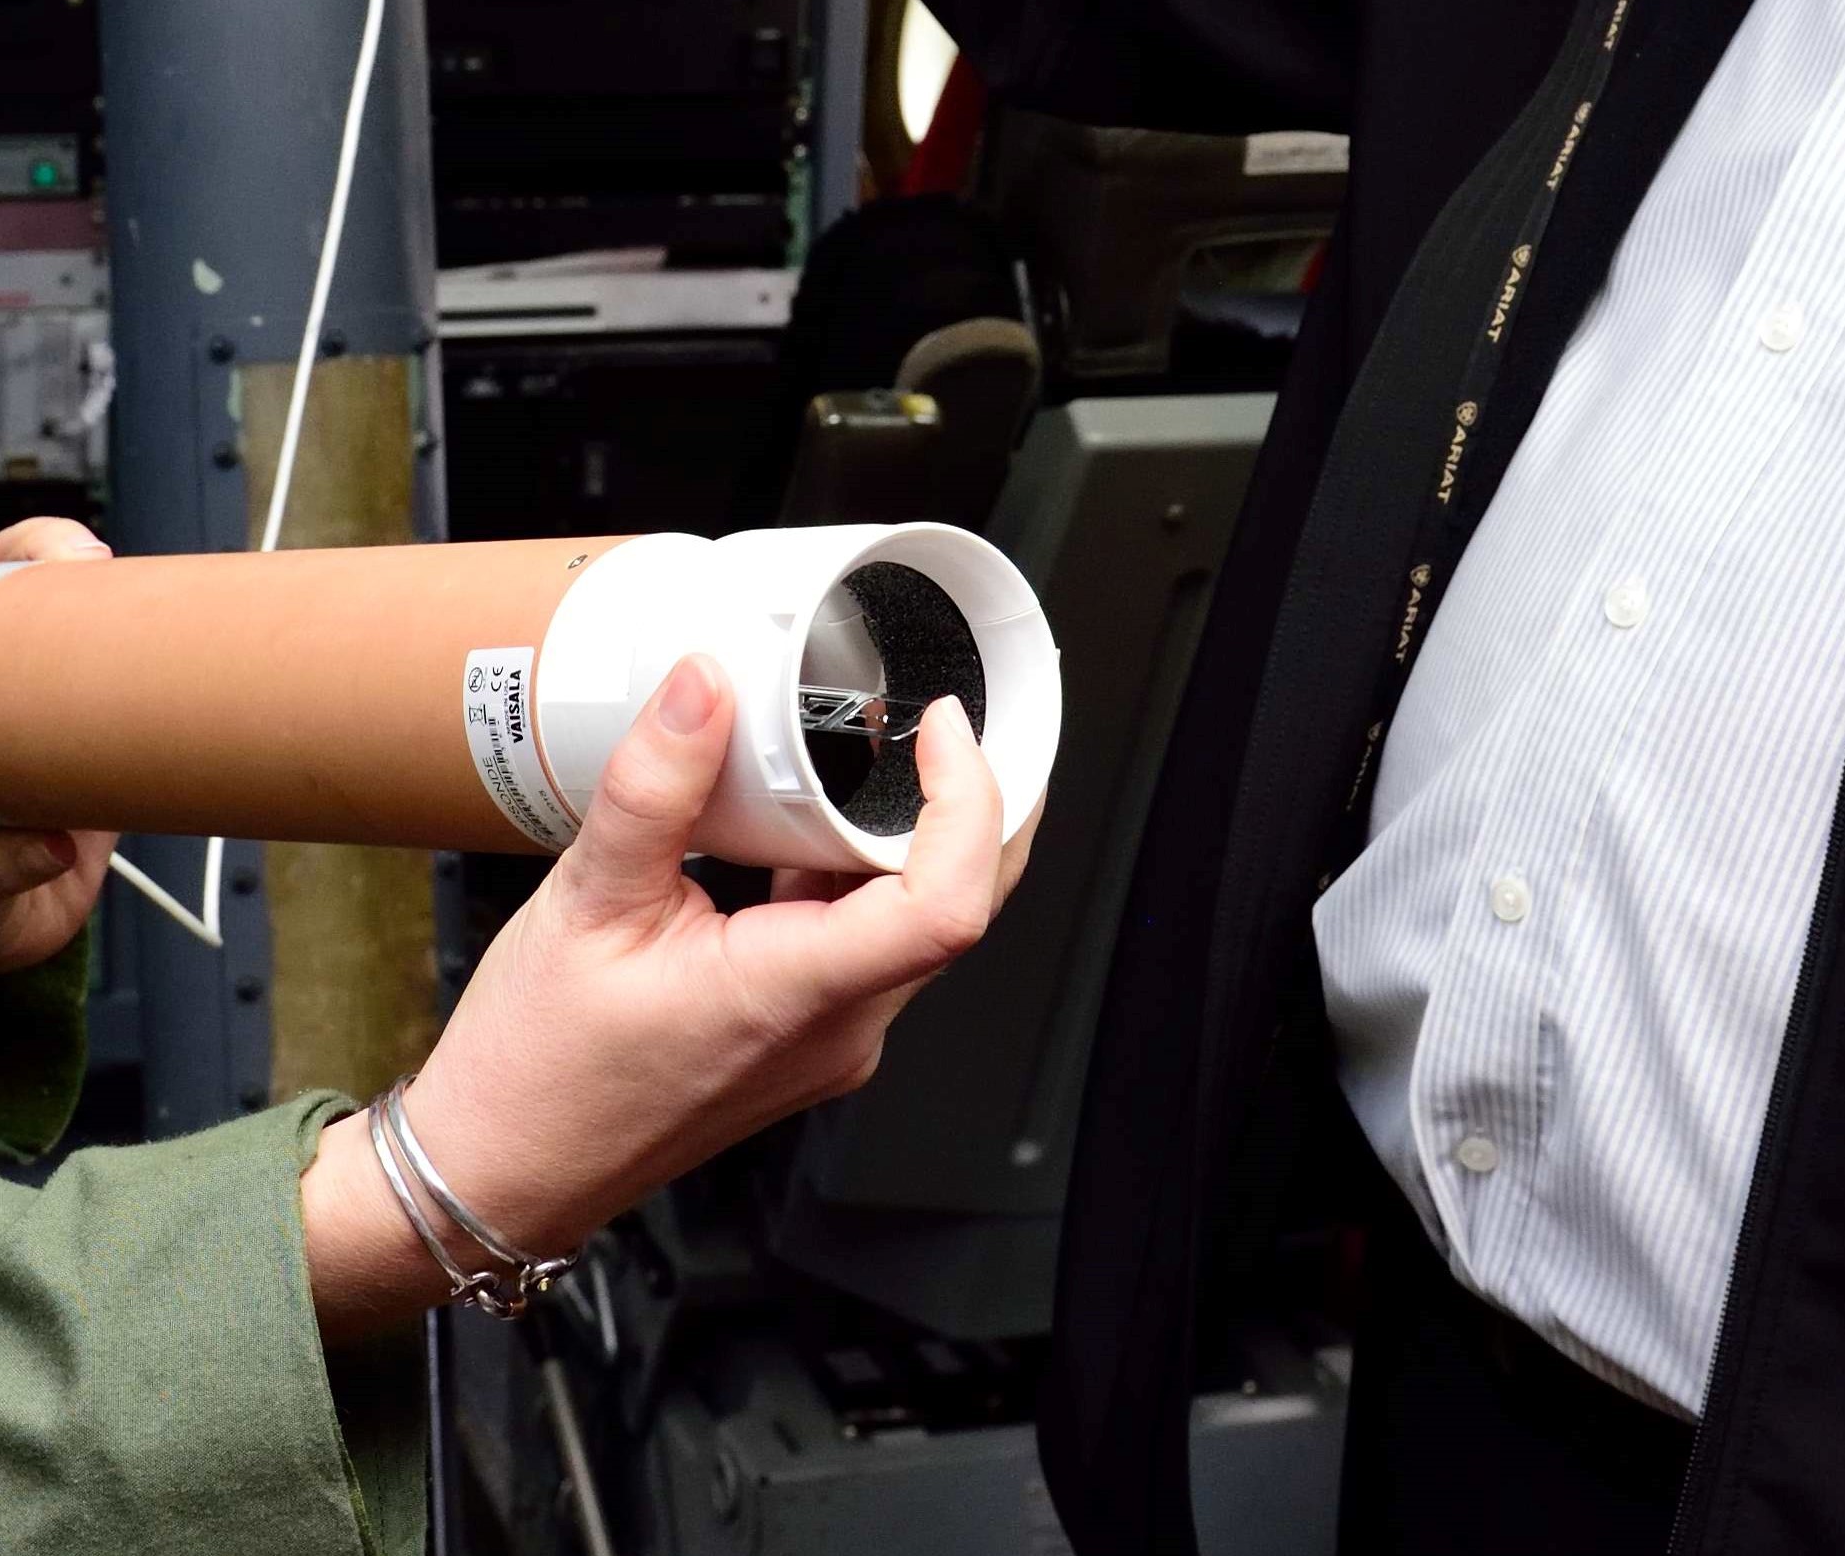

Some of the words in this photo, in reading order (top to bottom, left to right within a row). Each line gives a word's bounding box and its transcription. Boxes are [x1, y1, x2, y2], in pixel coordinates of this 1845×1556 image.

[1546, 124, 1580, 191] ARIAT
[1487, 267, 1521, 343] ARIAT
[1437, 425, 1467, 504] ARIAT
[1395, 588, 1422, 664] ARIAT
[508, 669, 524, 743] VAISALA
